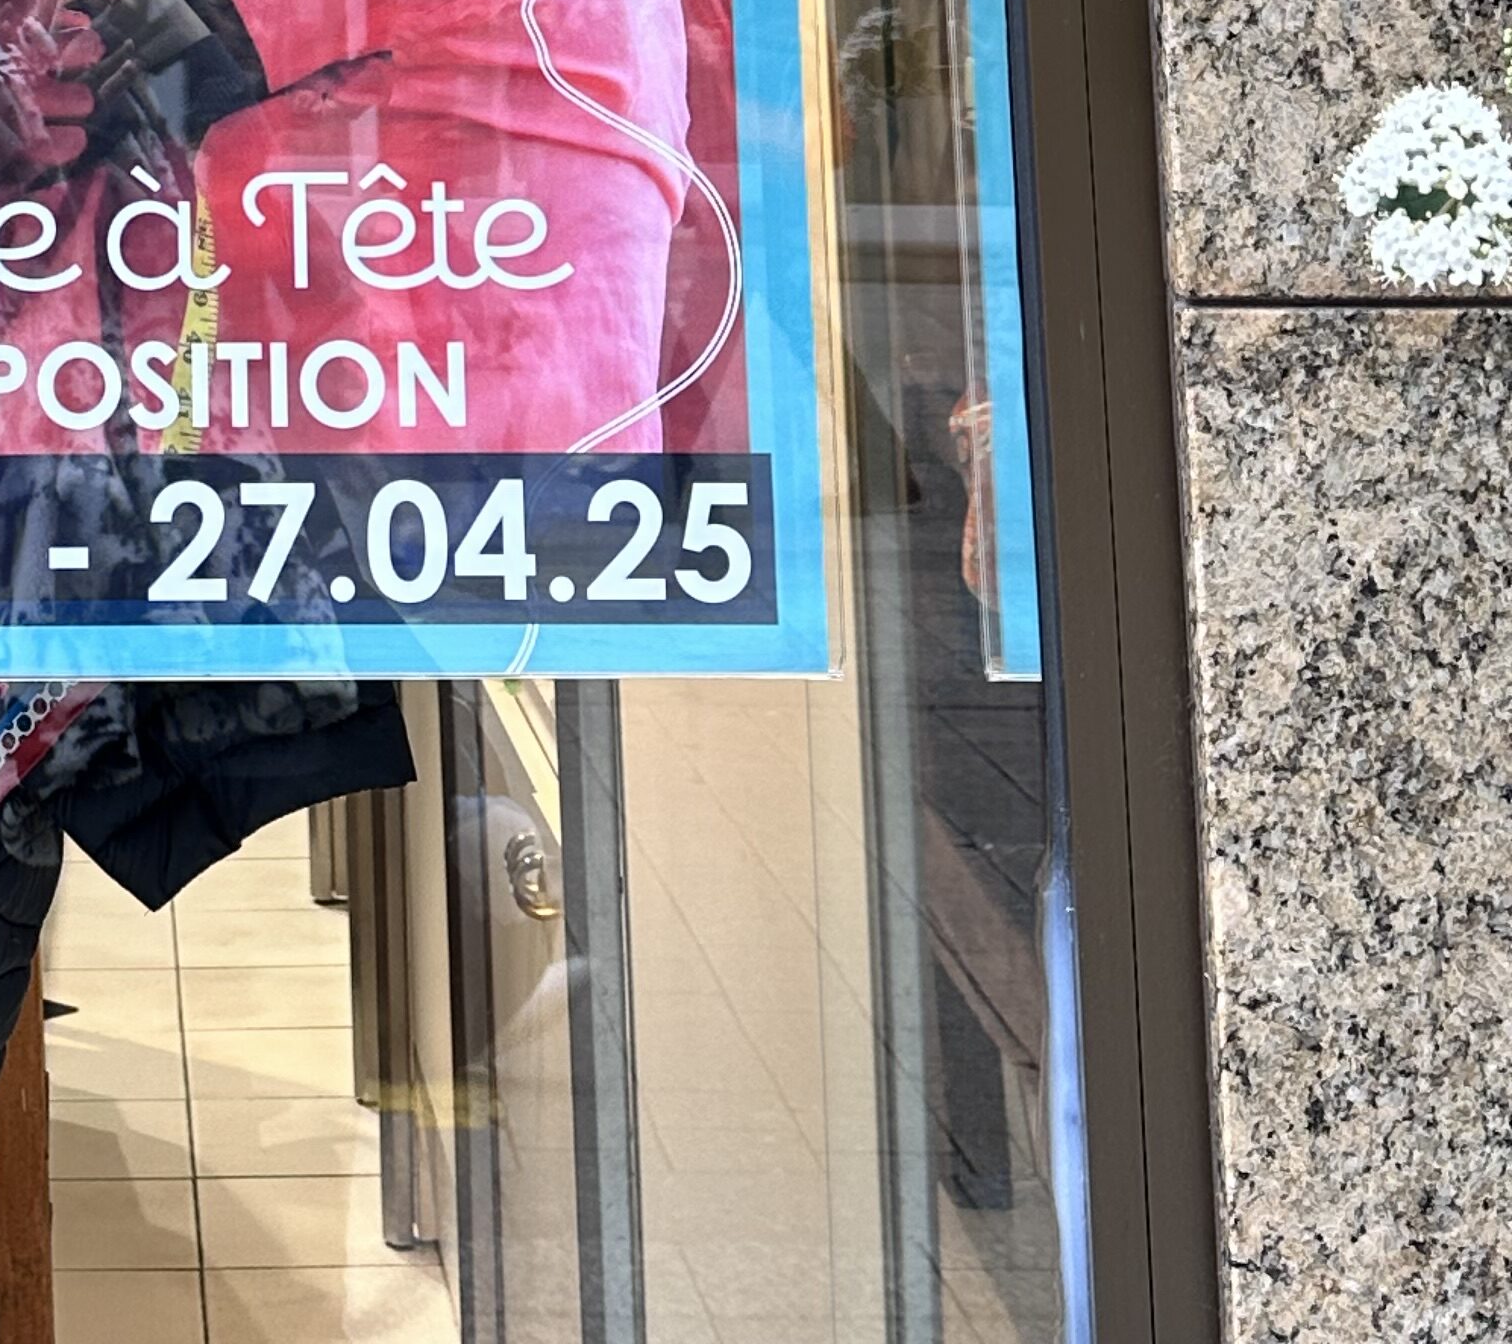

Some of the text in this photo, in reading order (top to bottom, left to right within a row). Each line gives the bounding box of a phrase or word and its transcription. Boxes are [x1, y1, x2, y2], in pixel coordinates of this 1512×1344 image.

[106, 164, 232, 291] à
[241, 162, 576, 291] Tête
[49, 547, 89, 569] -
[148, 479, 751, 603] 27.04.25
